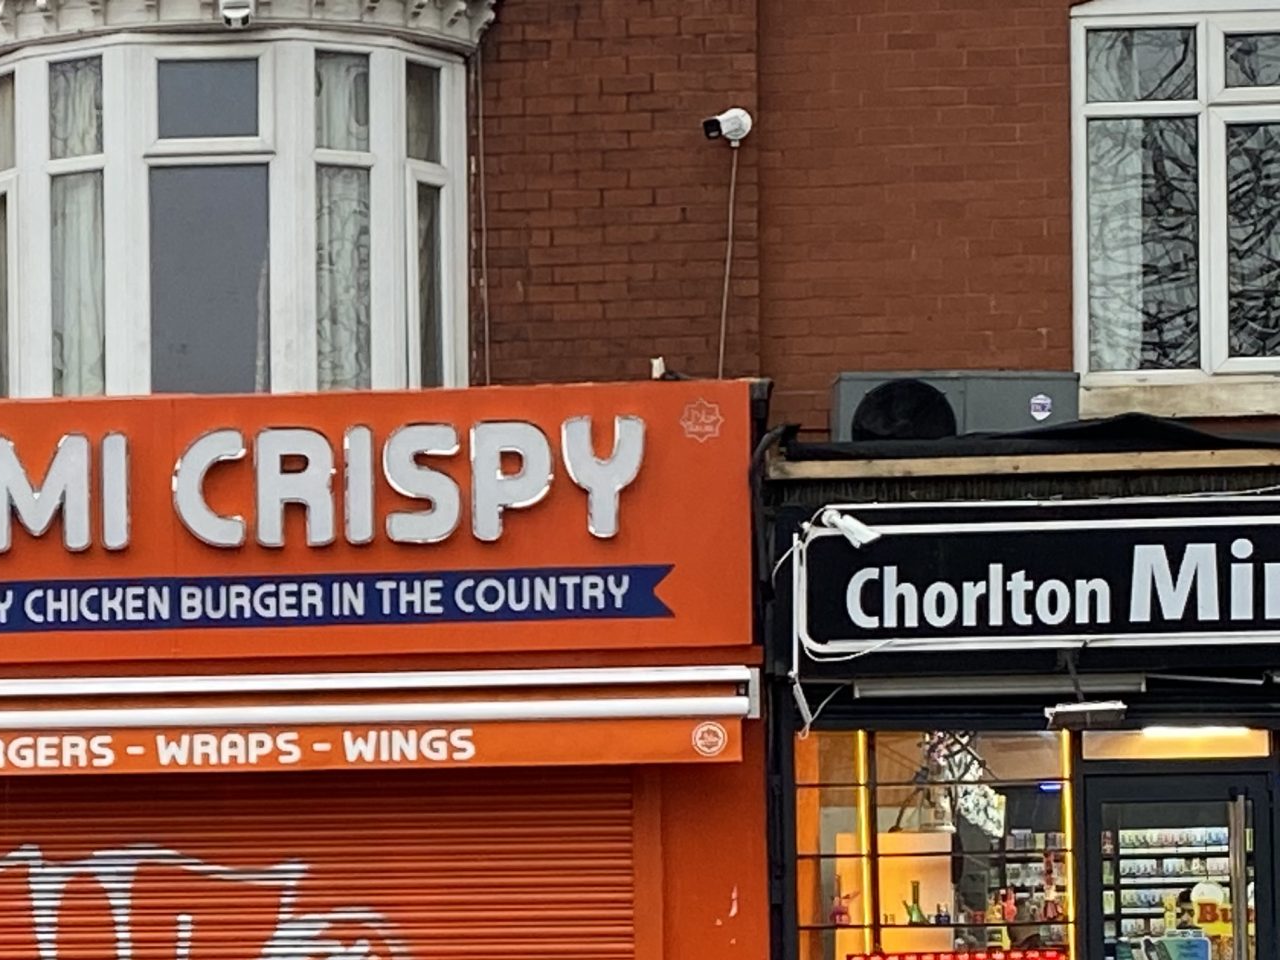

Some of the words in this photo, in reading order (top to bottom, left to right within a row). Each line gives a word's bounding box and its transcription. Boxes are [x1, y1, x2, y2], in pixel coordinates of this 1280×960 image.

[172, 415, 646, 548] CRISPY
[24, 586, 171, 624] CHICKEN
[180, 582, 324, 620] BURGER
[332, 580, 365, 617] IN
[375, 578, 444, 615] THE
[454, 574, 630, 613] COUNTRY
[845, 562, 1112, 629] Chorlton
[1128, 538, 1280, 623] Mi
[156, 731, 301, 767] WRAPS
[342, 728, 476, 763] WINGS
